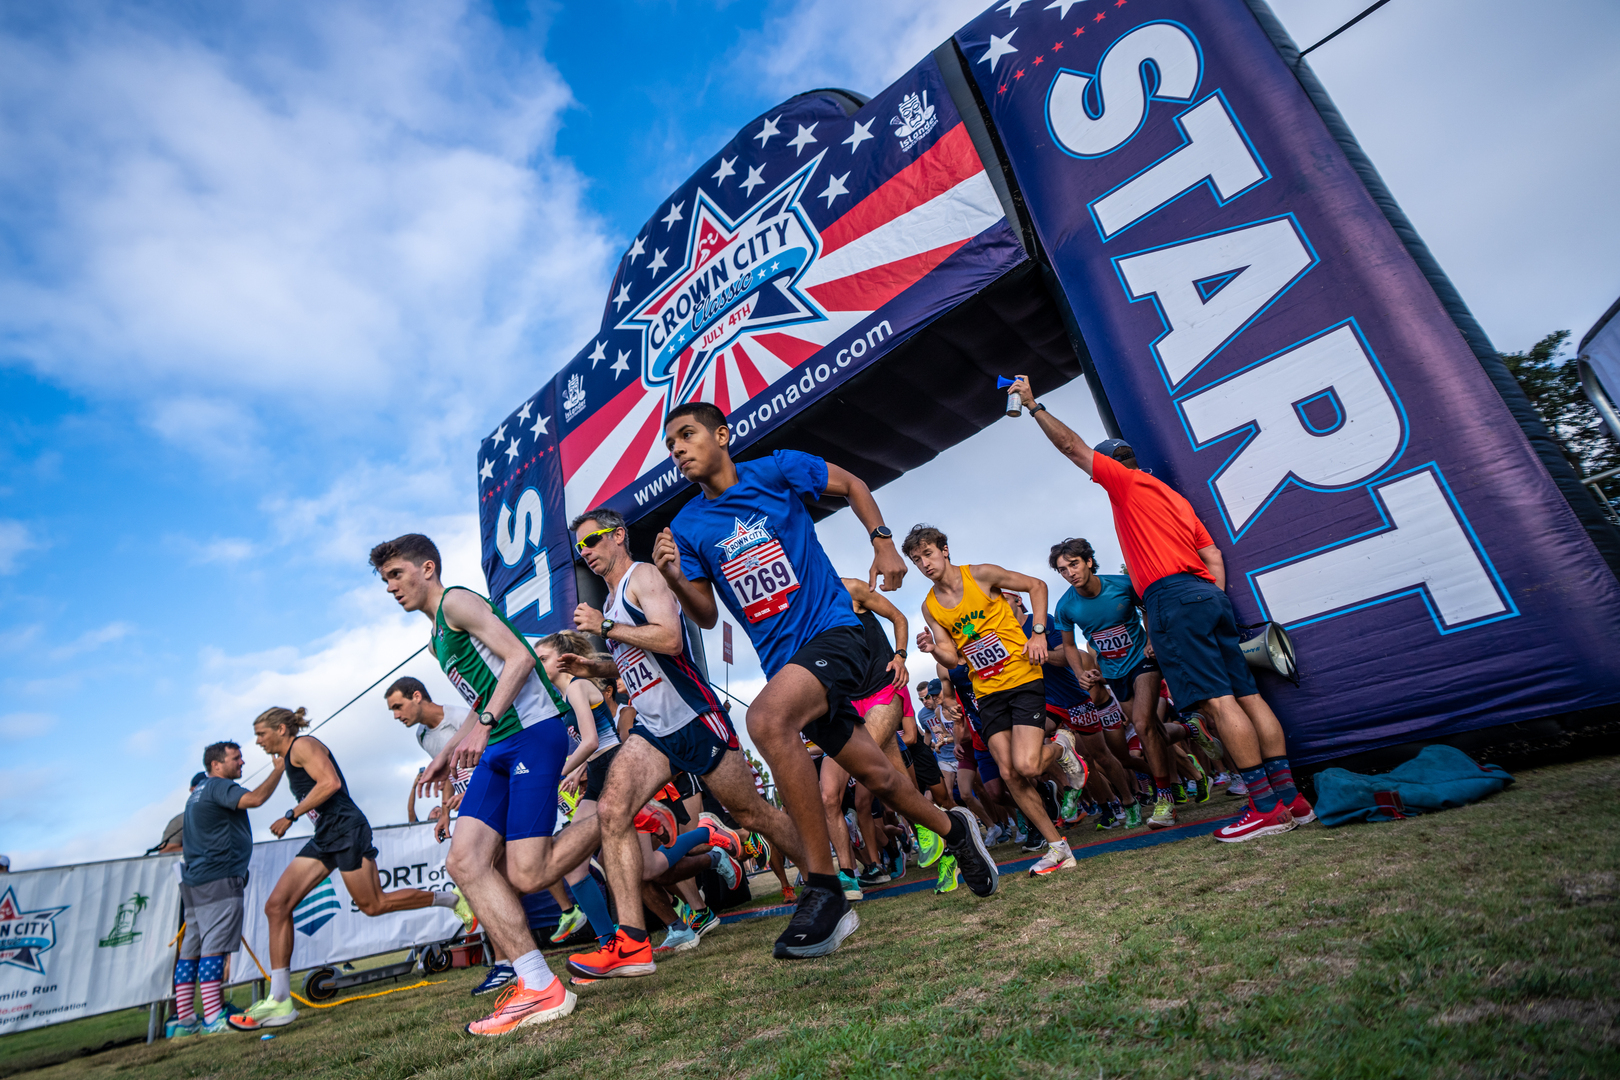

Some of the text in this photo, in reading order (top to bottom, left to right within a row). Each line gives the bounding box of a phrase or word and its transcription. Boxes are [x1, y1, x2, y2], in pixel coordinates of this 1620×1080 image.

[650, 216, 791, 350] CROWN CITY
[691, 271, 754, 332] Classic
[701, 303, 751, 349] JULY 4TH
[1046, 21, 1518, 633] START
[727, 534, 749, 555] CROWN
[748, 530, 764, 541] CITY
[733, 561, 791, 605] 1269
[951, 610, 986, 635] JAMUL
[1096, 633, 1131, 651] 2202
[970, 643, 1006, 669] 1695
[14, 922, 50, 936] CITY
[32, 983, 58, 996] Run
[33, 1002, 87, 1018] Foundation
